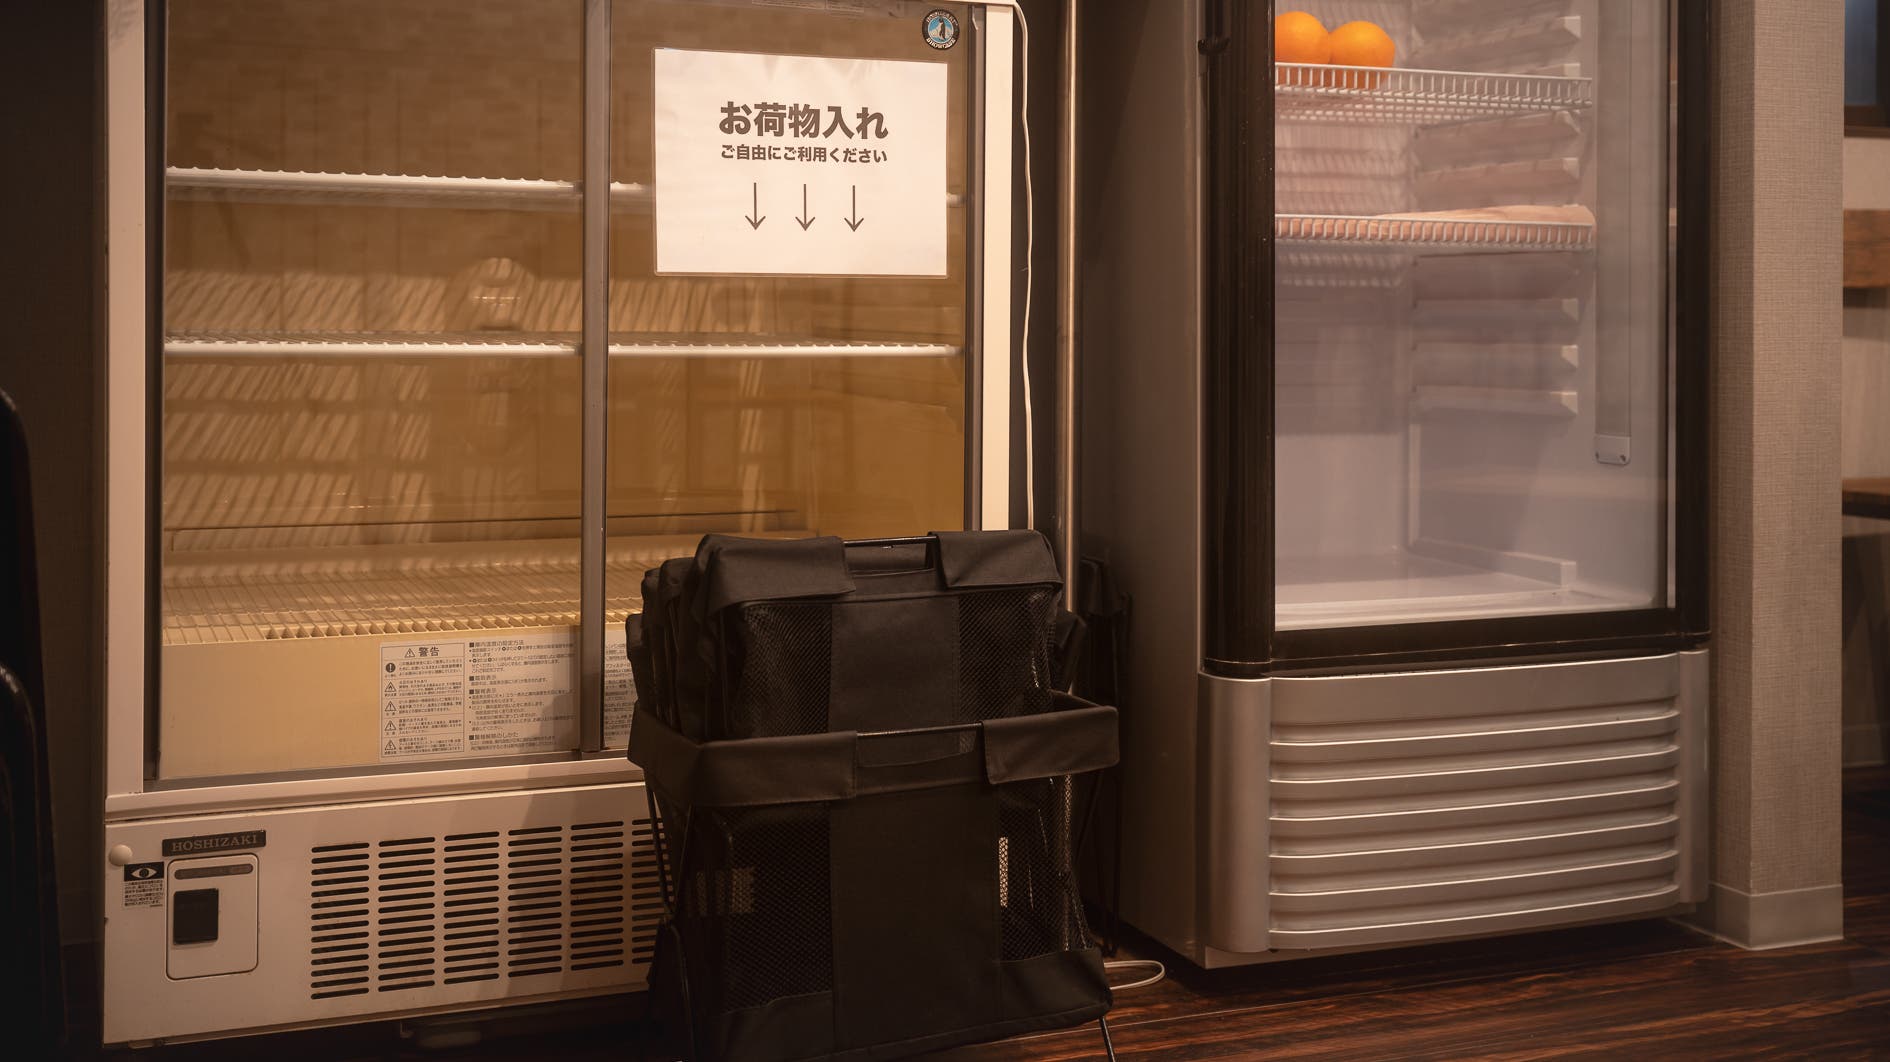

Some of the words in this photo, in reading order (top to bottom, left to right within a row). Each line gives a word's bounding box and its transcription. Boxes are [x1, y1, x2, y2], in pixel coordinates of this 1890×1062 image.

[719, 101, 889, 139] お荷物入れ
[720, 144, 888, 163] ご自由にご利用ください
[418, 646, 440, 657] 警告
[172, 835, 257, 852] HOSHIZAKI
